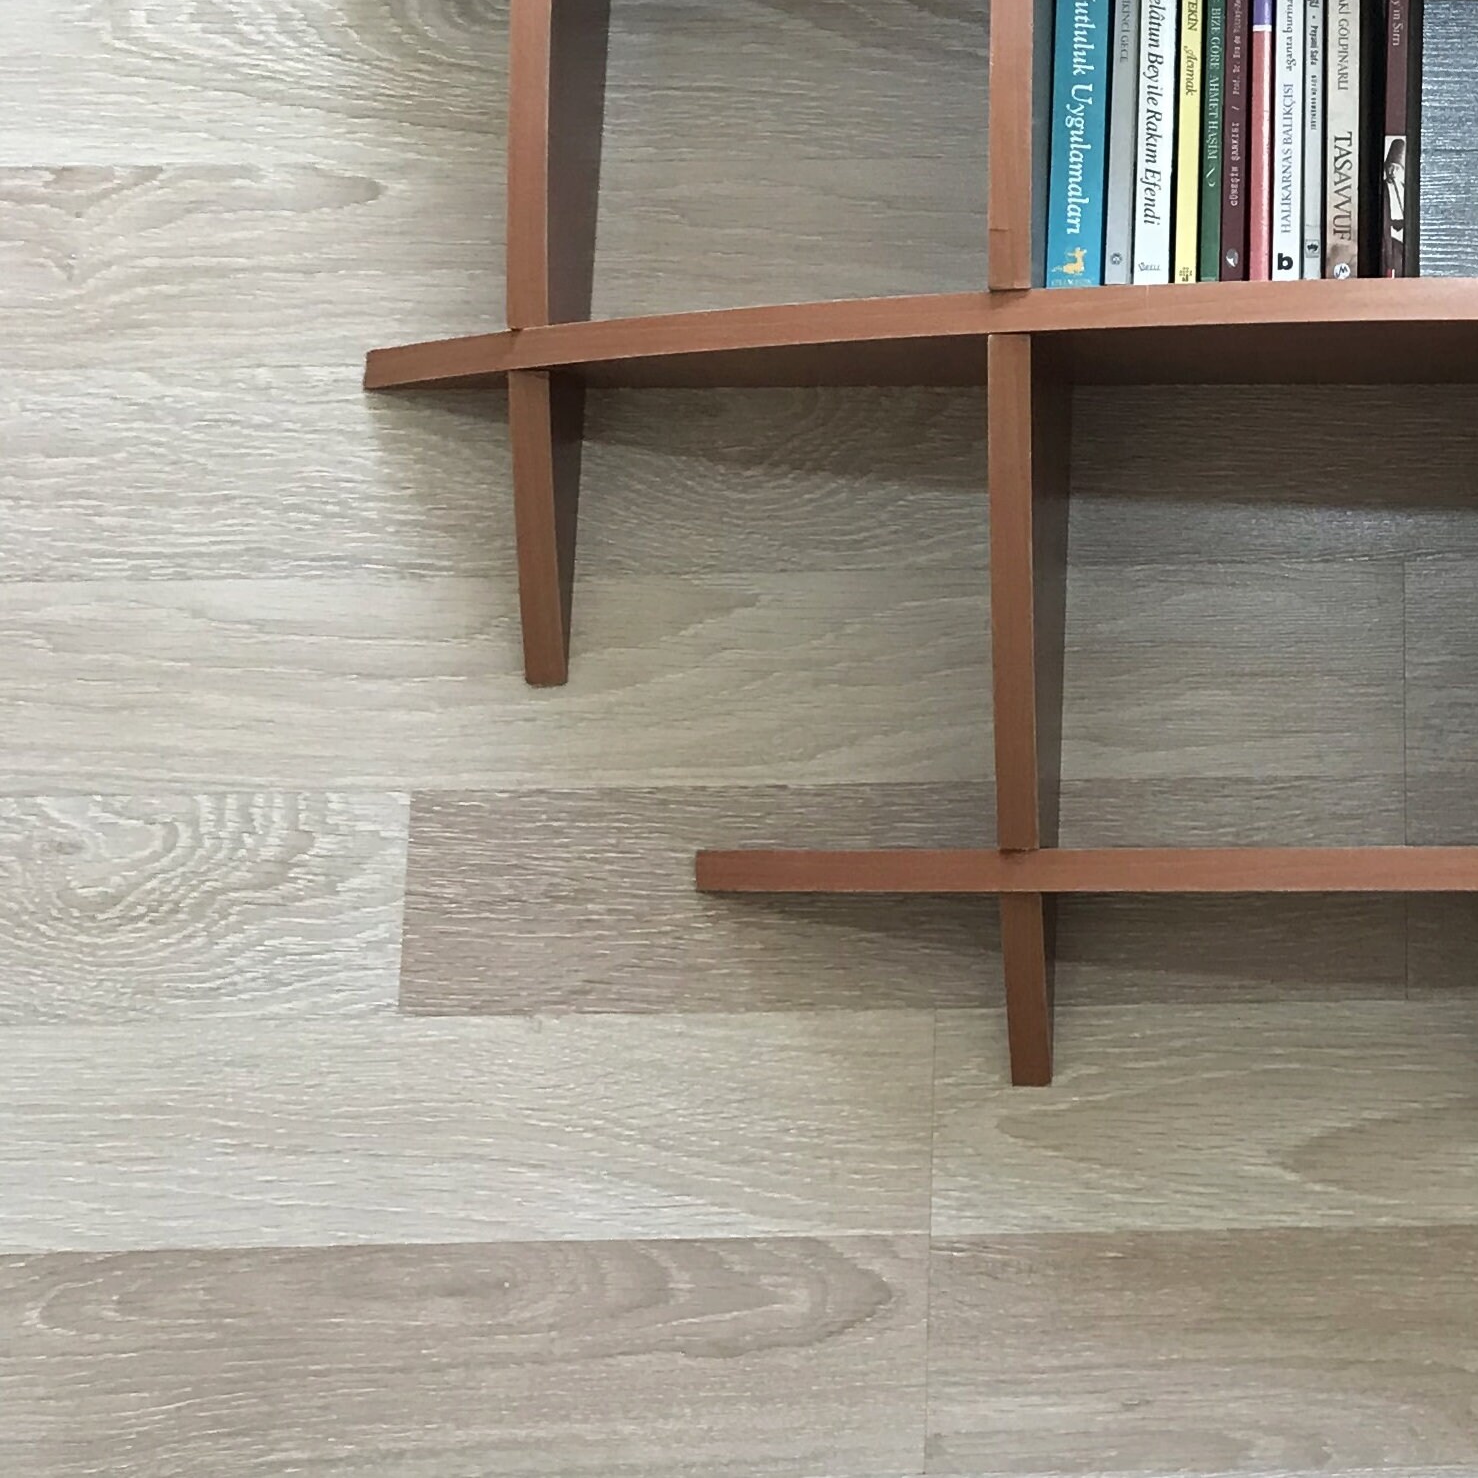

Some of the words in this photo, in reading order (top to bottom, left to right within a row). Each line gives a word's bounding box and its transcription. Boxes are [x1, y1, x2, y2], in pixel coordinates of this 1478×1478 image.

[1282, 0, 1294, 34] burina
[1120, 34, 1130, 63] GECE
[1143, 52, 1164, 84] Bey
[1210, 36, 1223, 70] GÖRE
[1285, 35, 1297, 72] aganta
[1337, 18, 1350, 91] GÖLPINARLI
[1147, 84, 1163, 106] ile
[1208, 74, 1219, 118] AHMET
[1282, 83, 1295, 146] BALIKÇISI
[1064, 83, 1093, 235] Uygulamaları
[1146, 108, 1162, 163] Rakım
[1140, 168, 1162, 225] Efendi
[1280, 148, 1293, 233] HALİKARNAS
[1332, 130, 1353, 241] TASAVVUF
